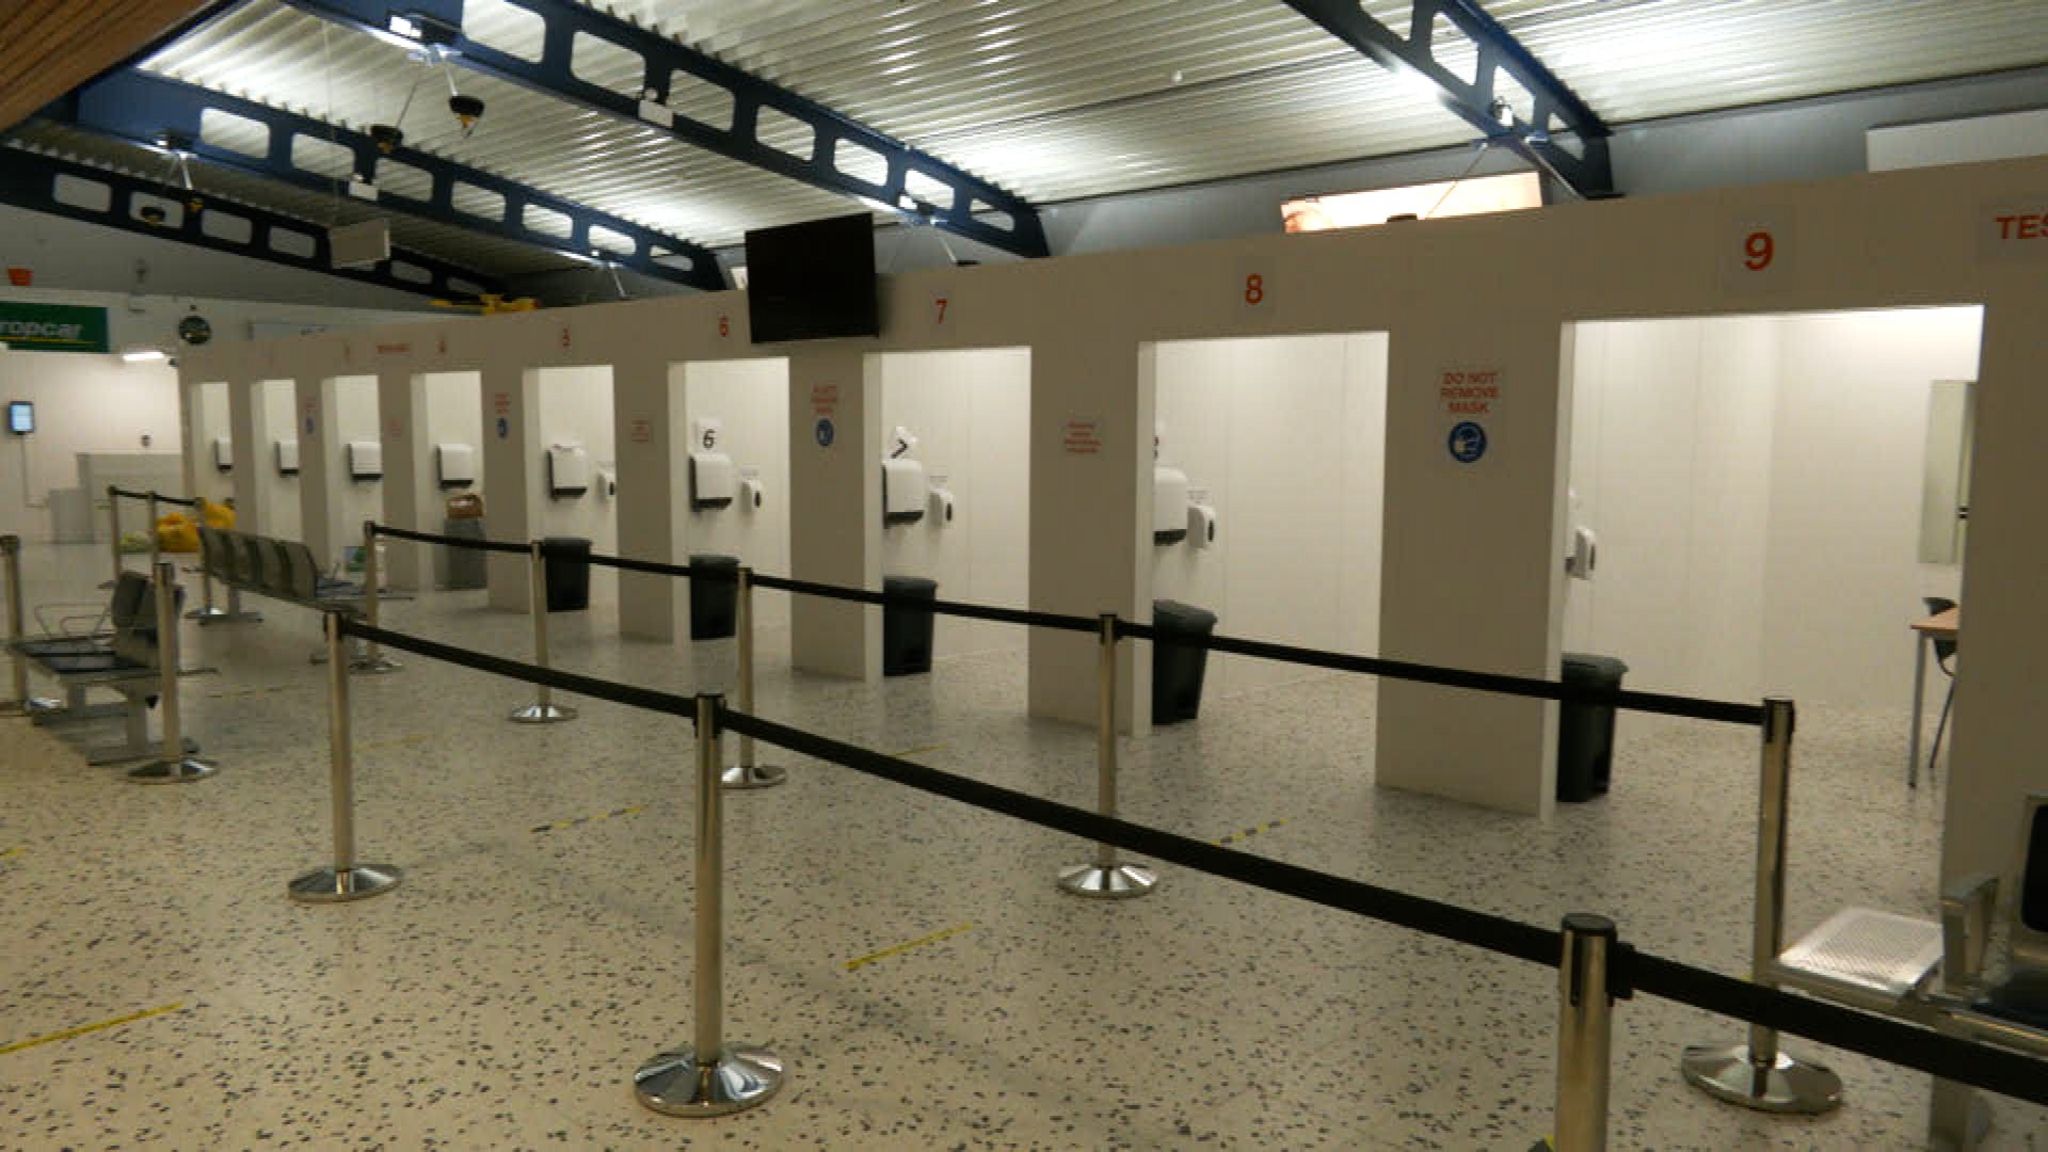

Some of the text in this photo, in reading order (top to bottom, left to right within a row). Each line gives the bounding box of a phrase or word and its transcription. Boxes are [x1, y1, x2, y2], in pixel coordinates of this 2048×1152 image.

[1743, 231, 1776, 272] 9
[1243, 273, 1264, 305] 8
[934, 298, 948, 325] 7
[718, 315, 730, 338] 6
[1443, 371, 1499, 385] DO NOT
[702, 428, 717, 449] 6
